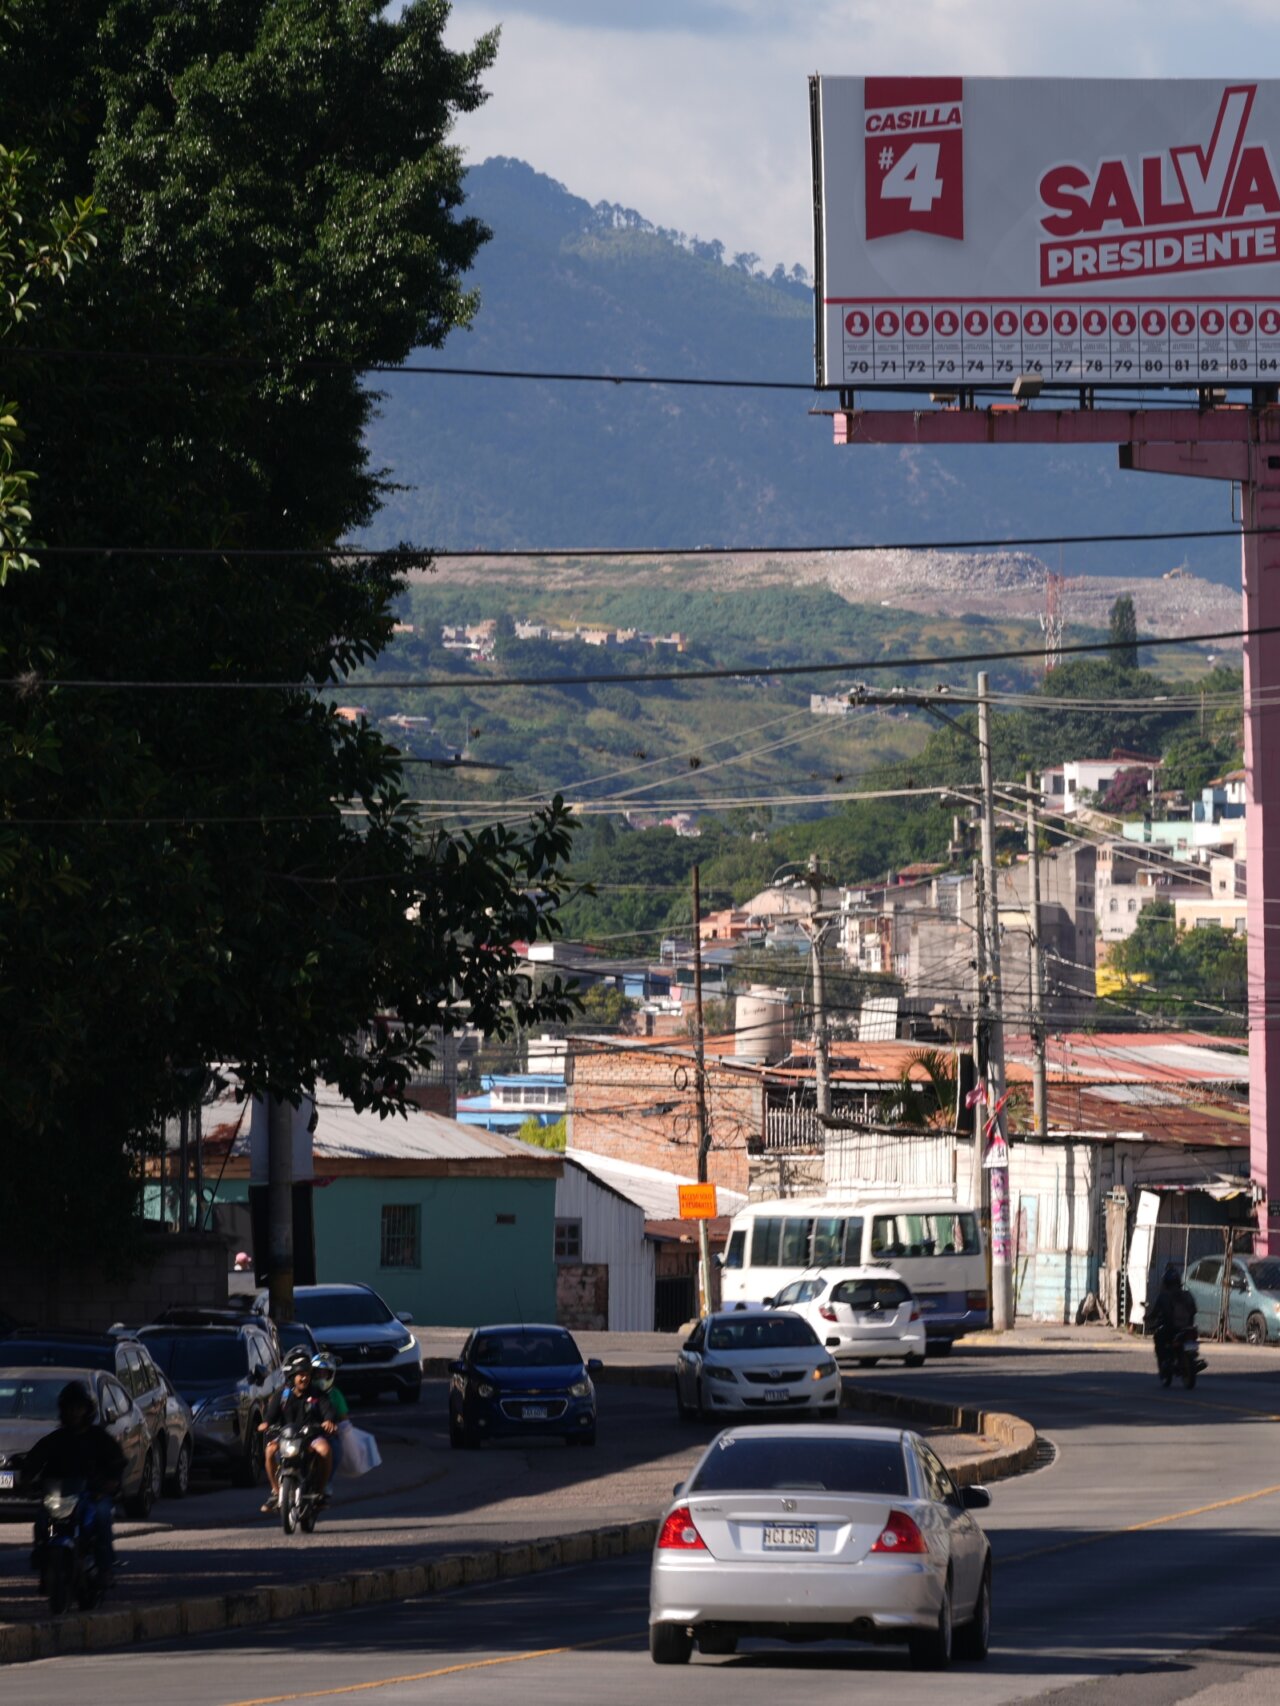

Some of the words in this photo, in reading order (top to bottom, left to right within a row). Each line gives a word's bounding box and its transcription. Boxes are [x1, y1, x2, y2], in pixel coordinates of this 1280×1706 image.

[865, 107, 962, 132] CASILLA
[878, 142, 944, 212] #4
[1047, 226, 1277, 279] PRESIDENTE
[850, 361, 868, 373] 70
[880, 361, 896, 373] 71
[907, 361, 925, 373] 72
[937, 361, 955, 373] 73
[967, 360, 984, 372] 74
[996, 360, 1013, 372] 75
[1025, 360, 1043, 372] 76
[1055, 360, 1072, 372] 77
[1085, 360, 1103, 372] 78
[1115, 360, 1133, 372] 79
[1144, 360, 1163, 372] 80
[1174, 360, 1190, 371] 81
[1201, 360, 1219, 371] 82
[1230, 359, 1248, 371] 83
[1260, 359, 1278, 371] 84
[763, 1528, 785, 1544] HCI
[787, 1528, 815, 1544] 1598
